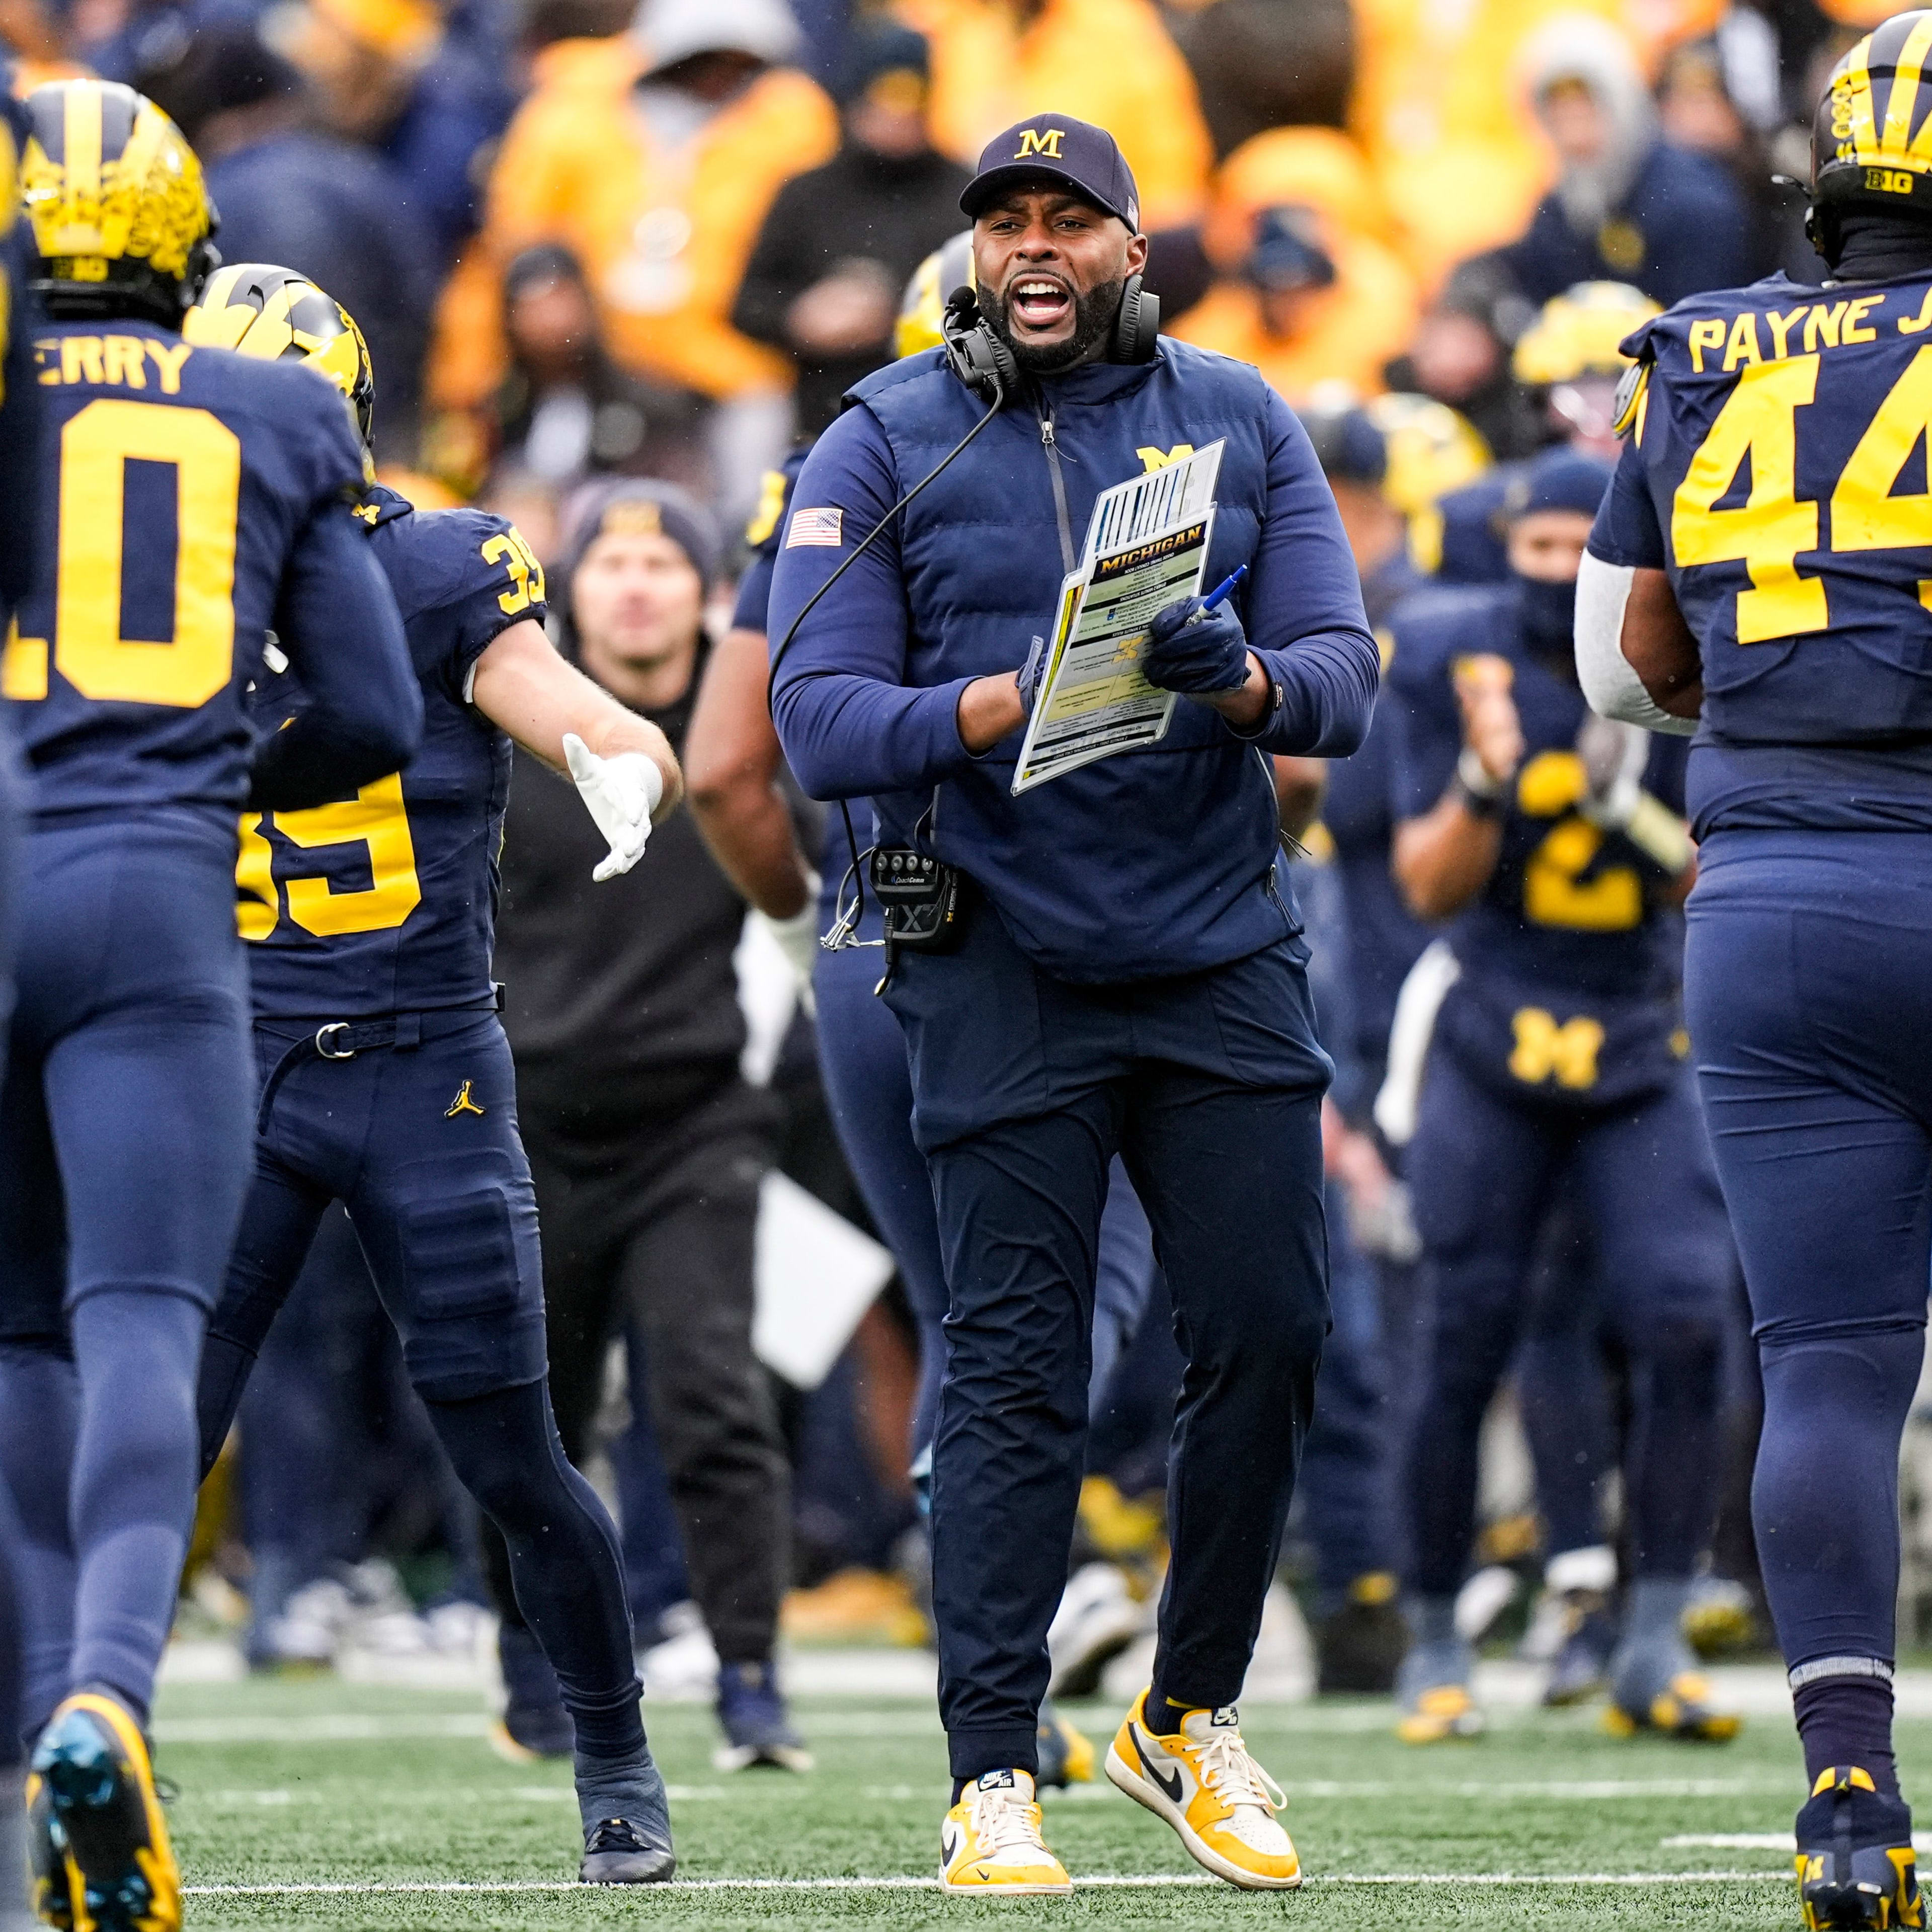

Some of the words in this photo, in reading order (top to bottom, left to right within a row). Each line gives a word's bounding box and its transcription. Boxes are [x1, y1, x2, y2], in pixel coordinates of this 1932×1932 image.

[1014, 129, 1065, 159] M
[1688, 294, 1885, 373] PAYNE
[1671, 344, 1932, 645] 44
[352, 503, 380, 525] M
[0, 398, 241, 708] 0
[1101, 525, 1201, 574] MICHIGAN
[901, 905, 922, 931] X
[1510, 1008, 1605, 1089] M
[1218, 1707, 1232, 1717] NIKE
[984, 1770, 1005, 1782] NIKE
[998, 1778, 1012, 1787] AIR
